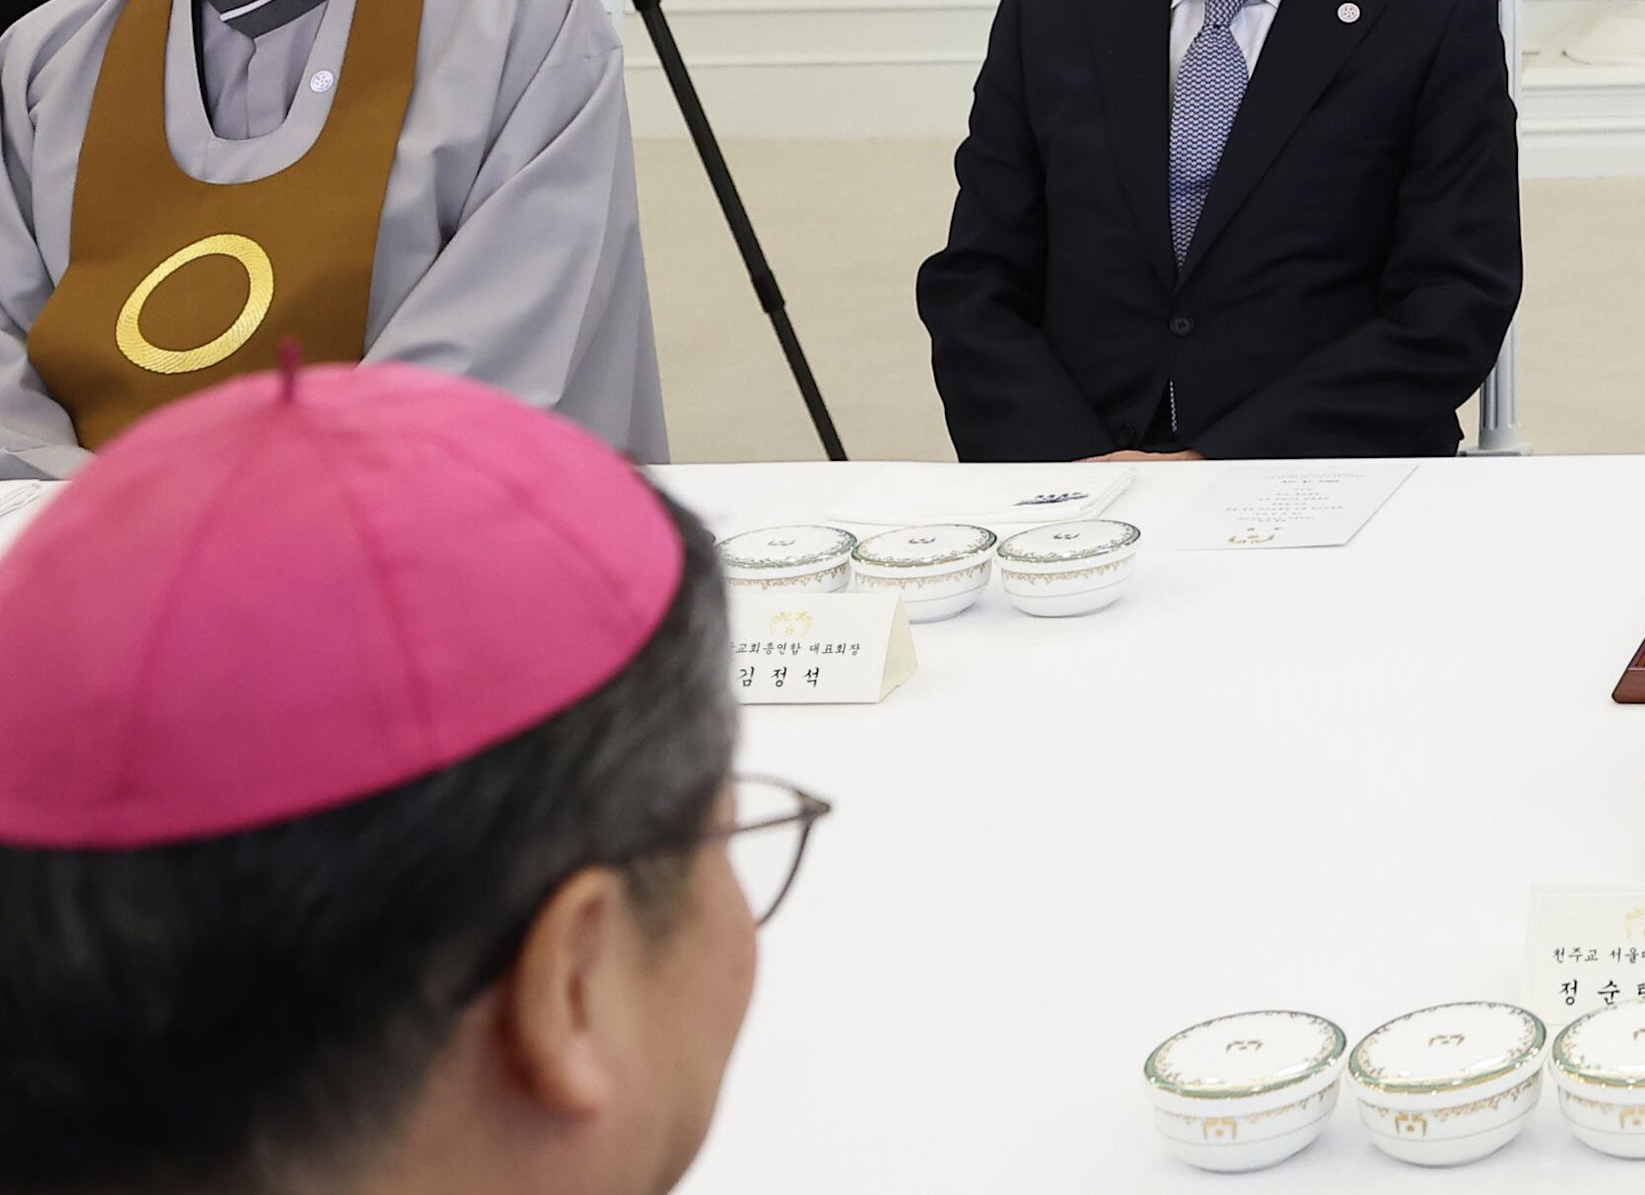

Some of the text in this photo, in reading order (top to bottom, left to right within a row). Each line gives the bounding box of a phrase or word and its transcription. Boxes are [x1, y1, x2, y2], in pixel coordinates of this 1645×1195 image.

[731, 641, 861, 657] 교회총연합 대표회장
[1552, 946, 1599, 964] 천주교
